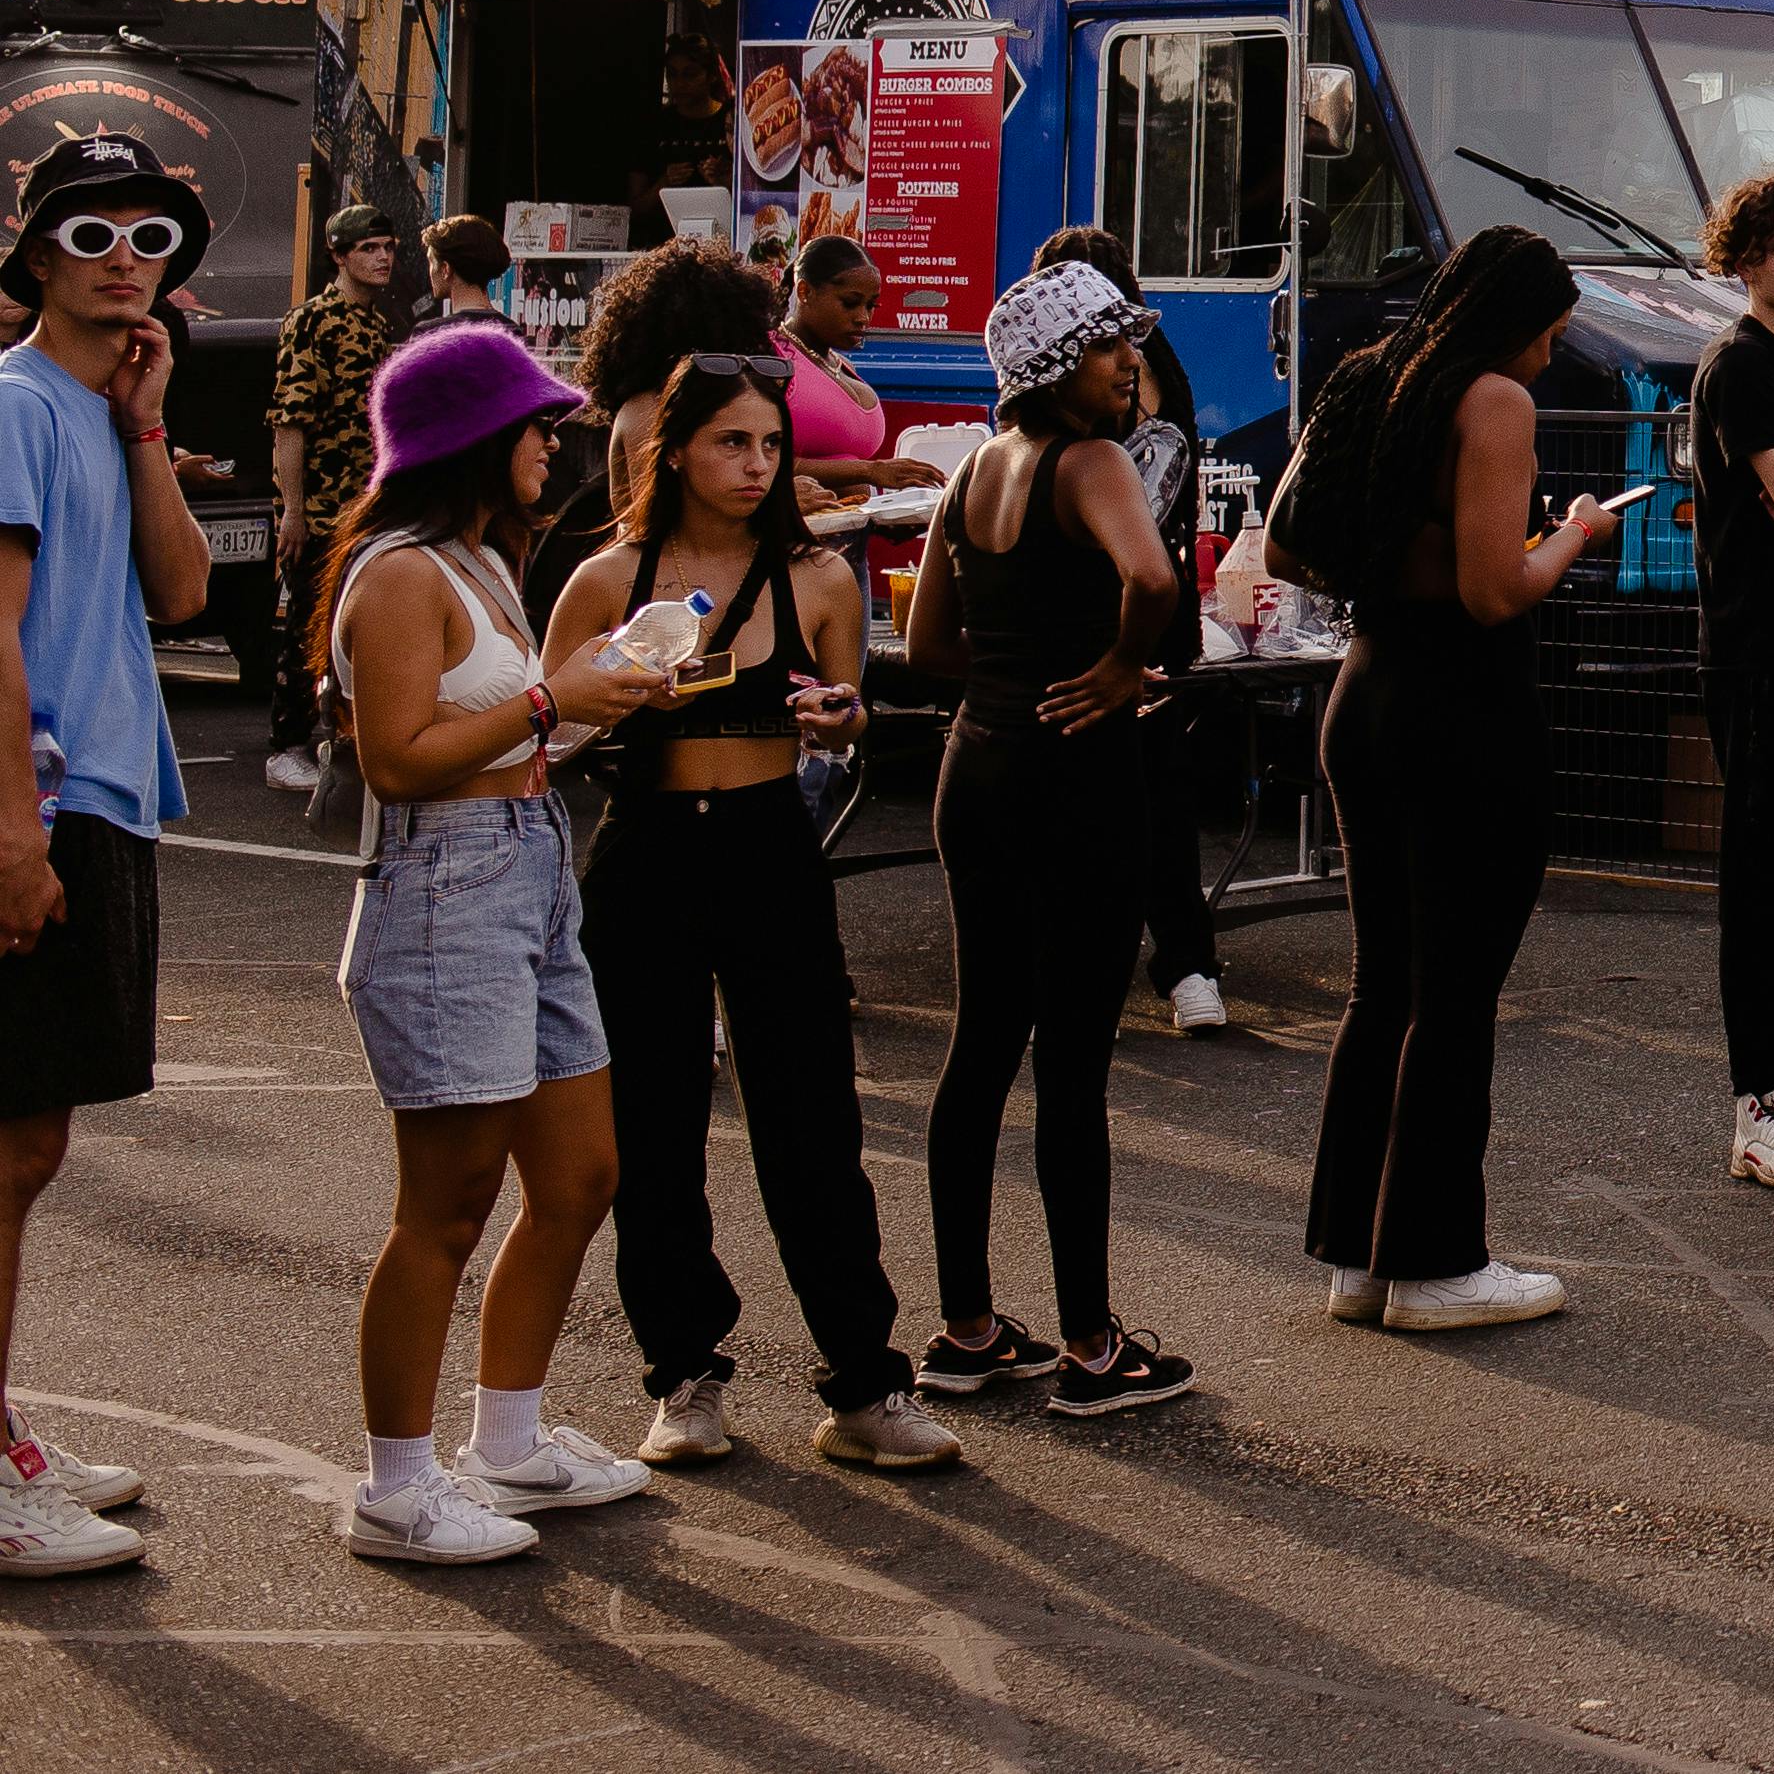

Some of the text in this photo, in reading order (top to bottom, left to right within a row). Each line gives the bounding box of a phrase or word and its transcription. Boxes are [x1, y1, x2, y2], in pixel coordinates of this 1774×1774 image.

[910, 41, 968, 60] MENU
[879, 77, 993, 92] BURGER COMBOS
[12, 80, 99, 112] ULTIMATE
[102, 81, 150, 103] FOOD
[154, 94, 211, 141] TRUCK
[897, 181, 959, 195] POUTINES
[908, 216, 937, 224] OUTINE
[899, 257, 913, 265] HOT
[915, 257, 931, 265] DOG
[511, 288, 586, 327] Fusion
[896, 313, 949, 329] WATER
[223, 530, 266, 552] 81377
